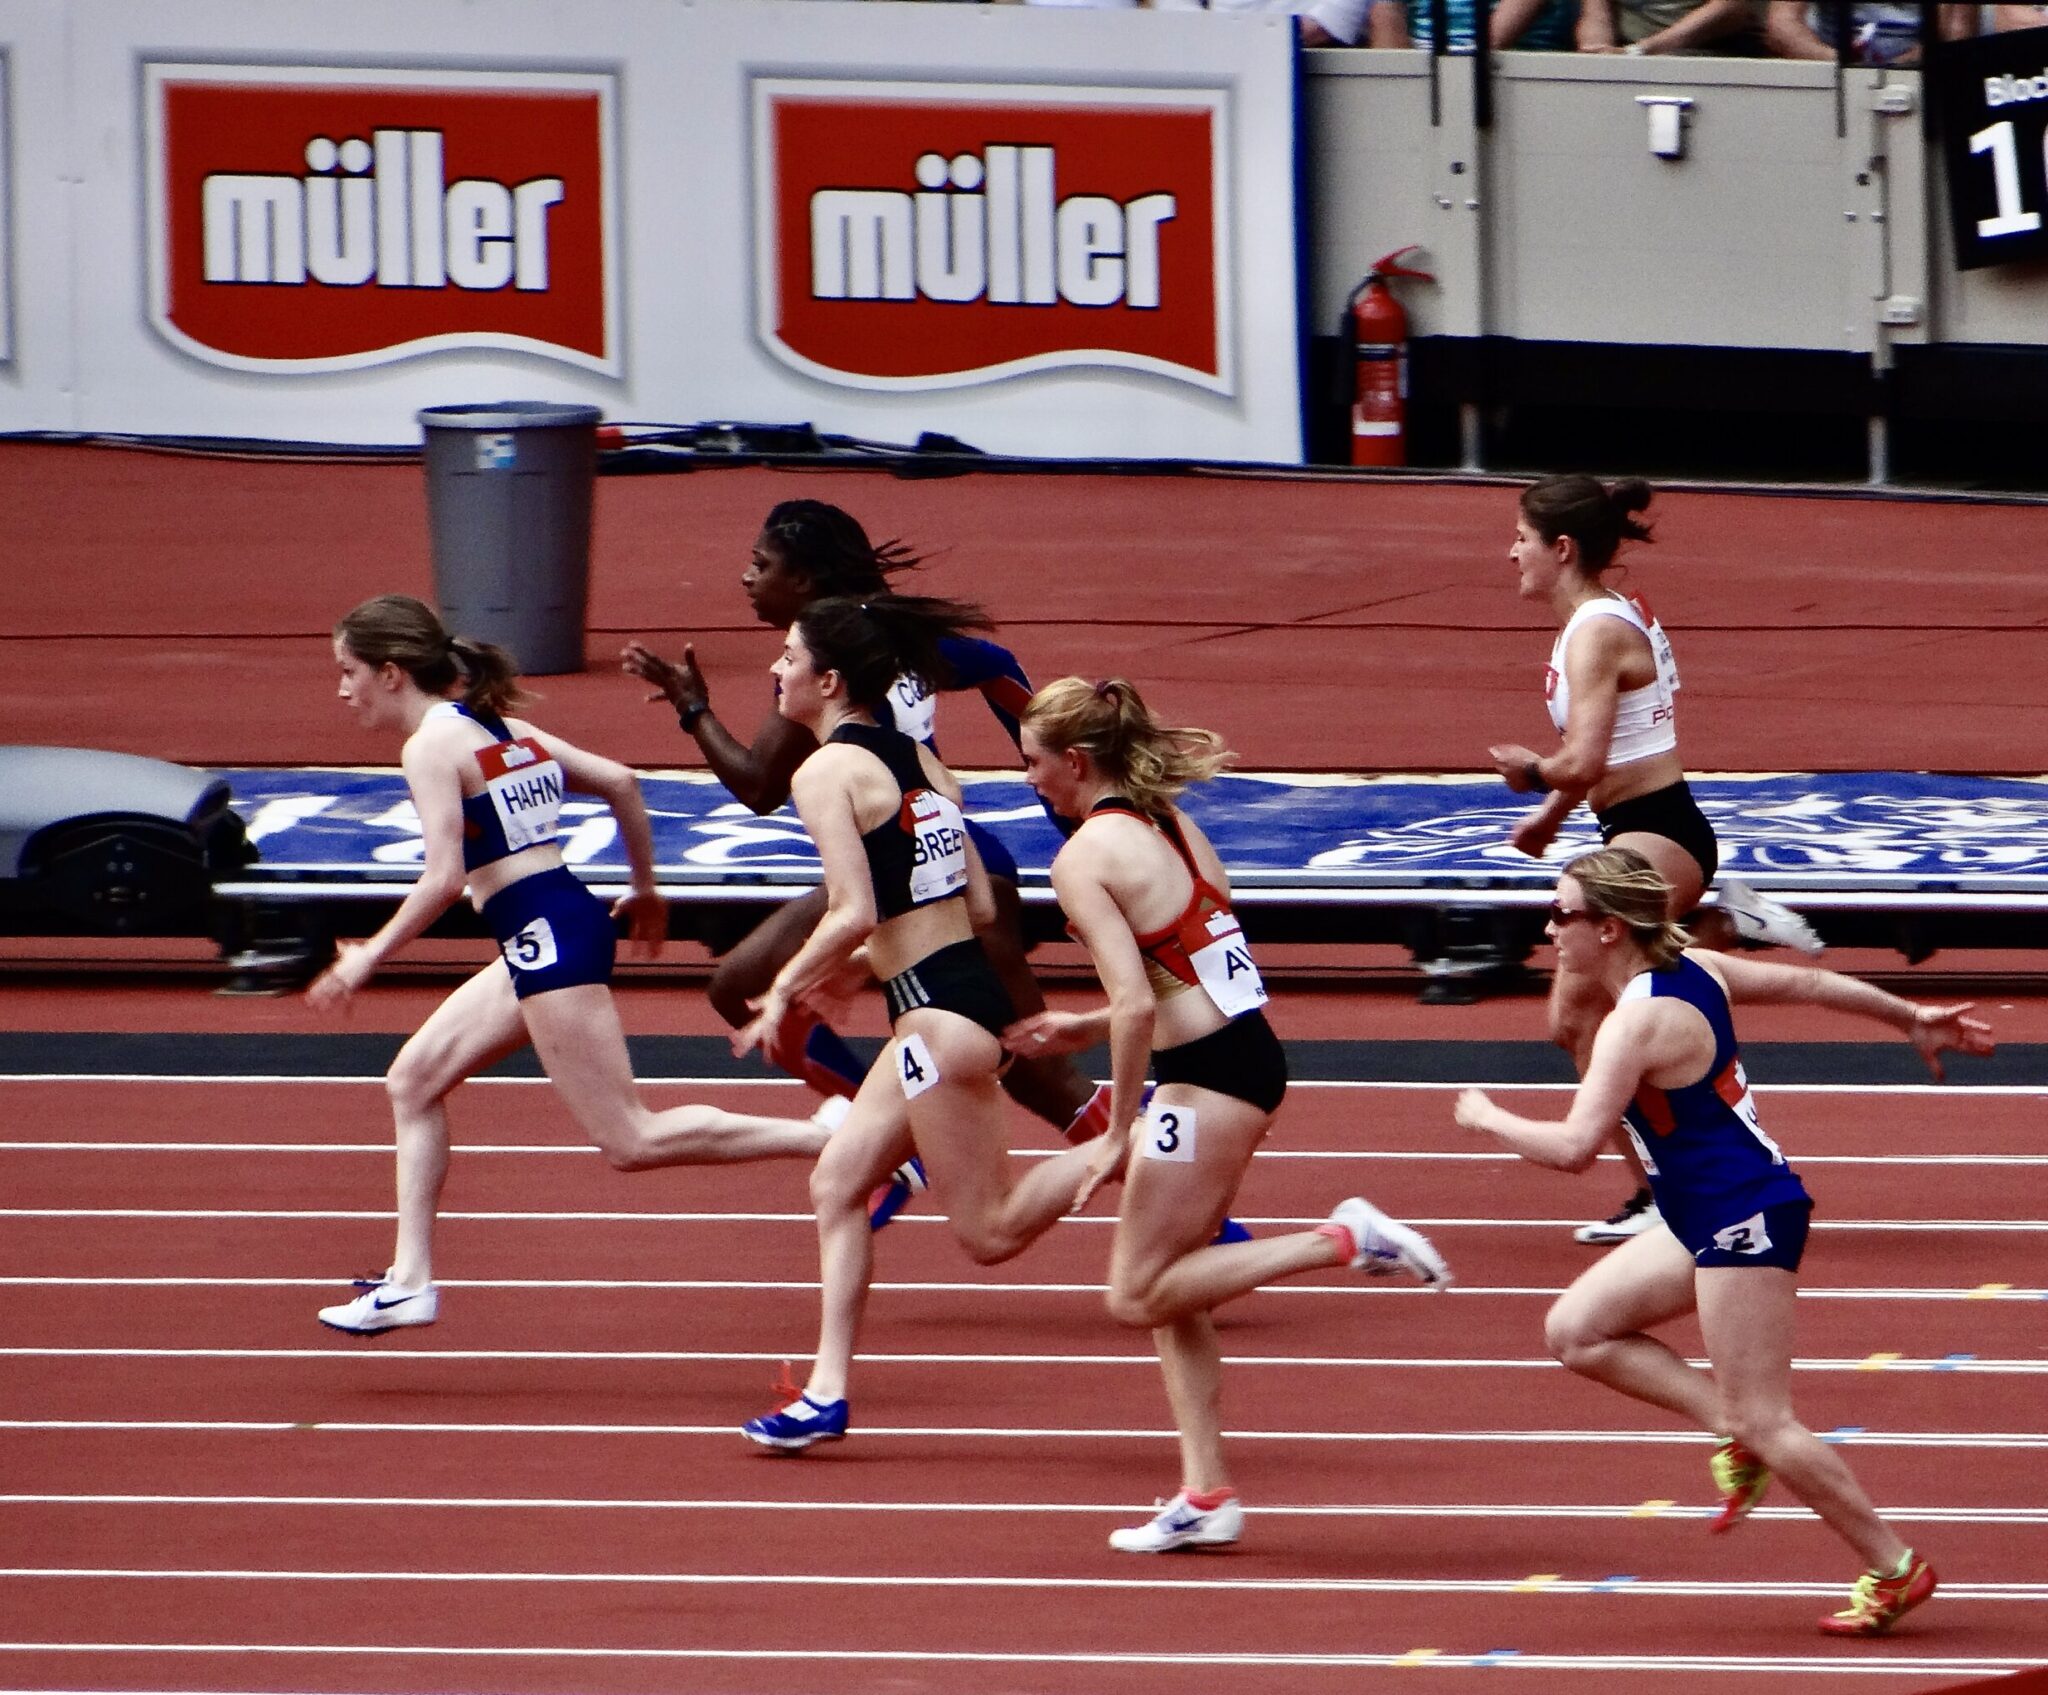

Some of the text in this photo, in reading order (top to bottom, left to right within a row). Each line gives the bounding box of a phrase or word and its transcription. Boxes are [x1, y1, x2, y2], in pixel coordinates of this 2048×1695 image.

[1984, 66, 2048, 106] Bloc
[1969, 121, 2048, 238] 1
[202, 130, 564, 291] müller
[811, 145, 1176, 307] müller
[501, 773, 560, 815] HAHN
[516, 931, 540, 963] 5
[904, 1046, 924, 1082] 4
[1157, 1112, 1179, 1153] 3
[1728, 1227, 1755, 1251] 2
